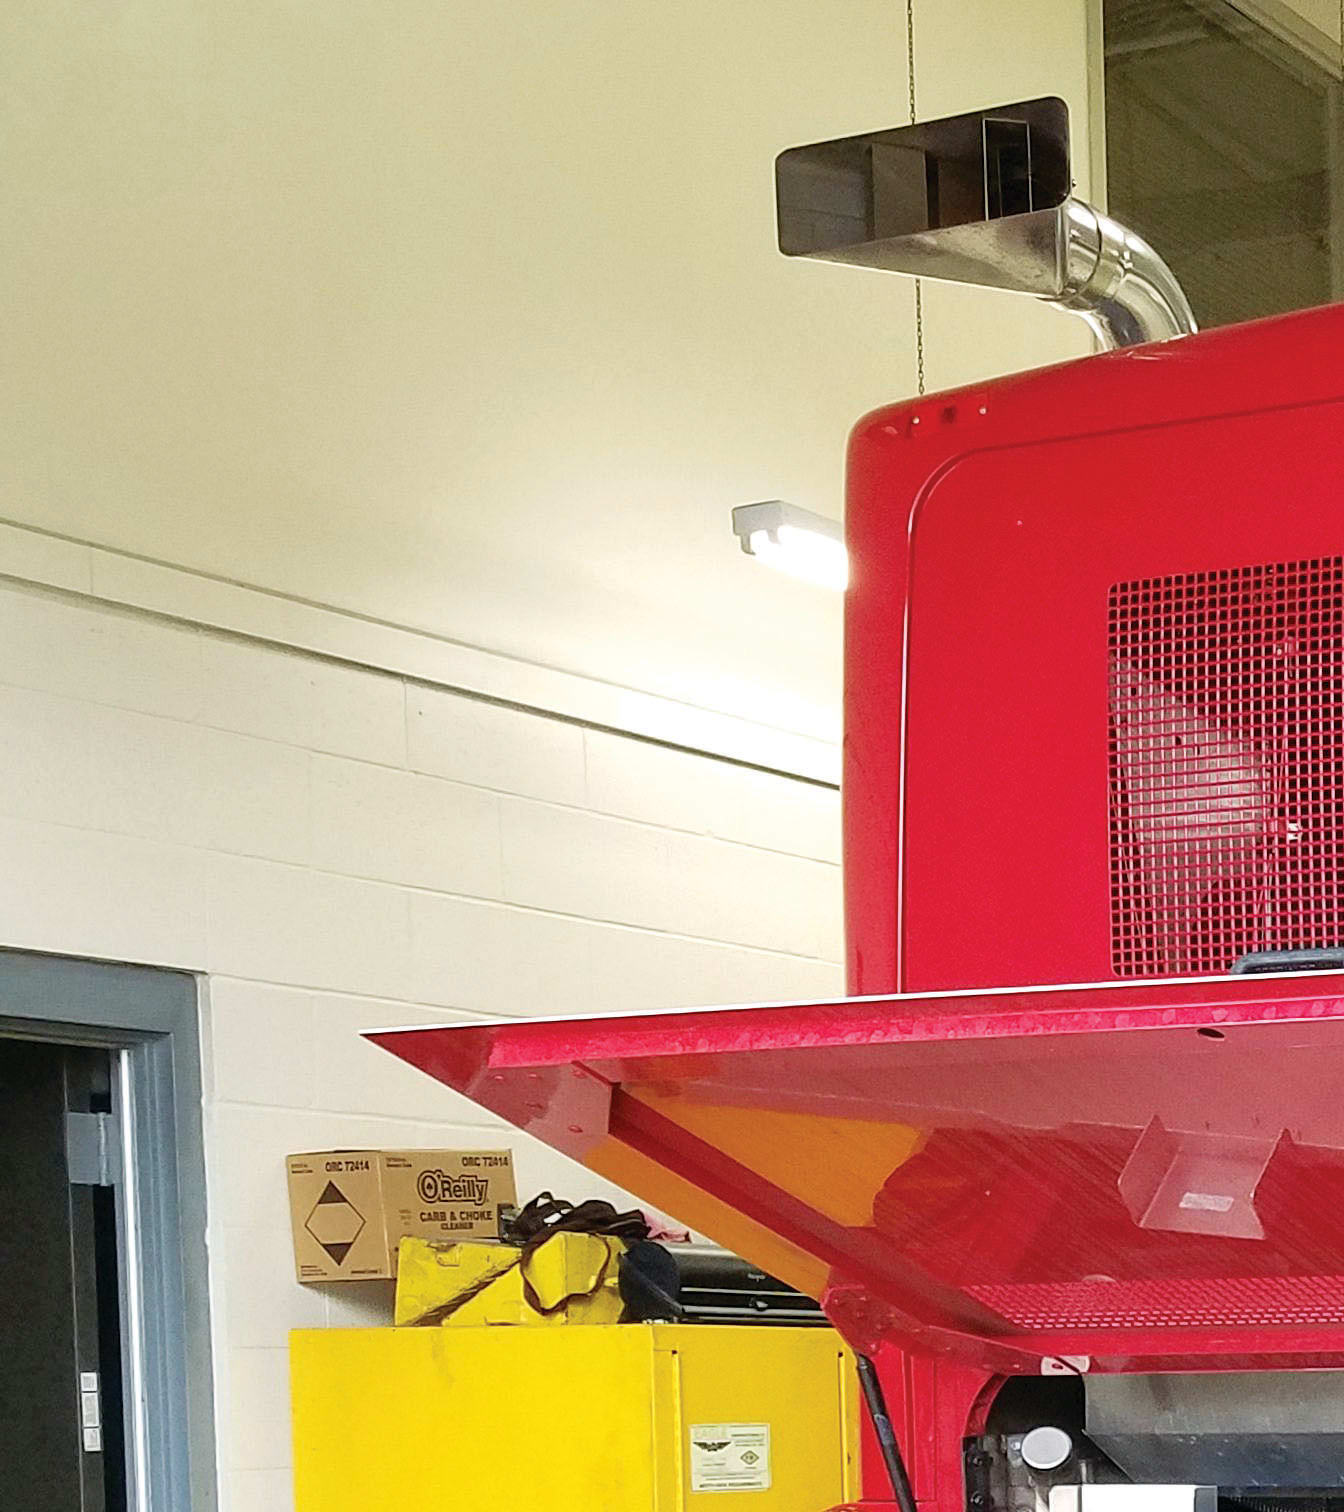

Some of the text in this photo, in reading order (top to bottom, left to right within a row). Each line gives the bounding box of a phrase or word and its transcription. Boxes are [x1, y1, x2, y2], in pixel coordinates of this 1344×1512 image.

[345, 1160, 370, 1172] 72414
[482, 1156, 509, 1167] 72414
[418, 1171, 488, 1204] O'Reilly
[419, 1211, 447, 1222] CARB
[449, 1211, 457, 1221] &
[459, 1210, 493, 1221] CHOKE
[440, 1222, 474, 1231] CLEANER
